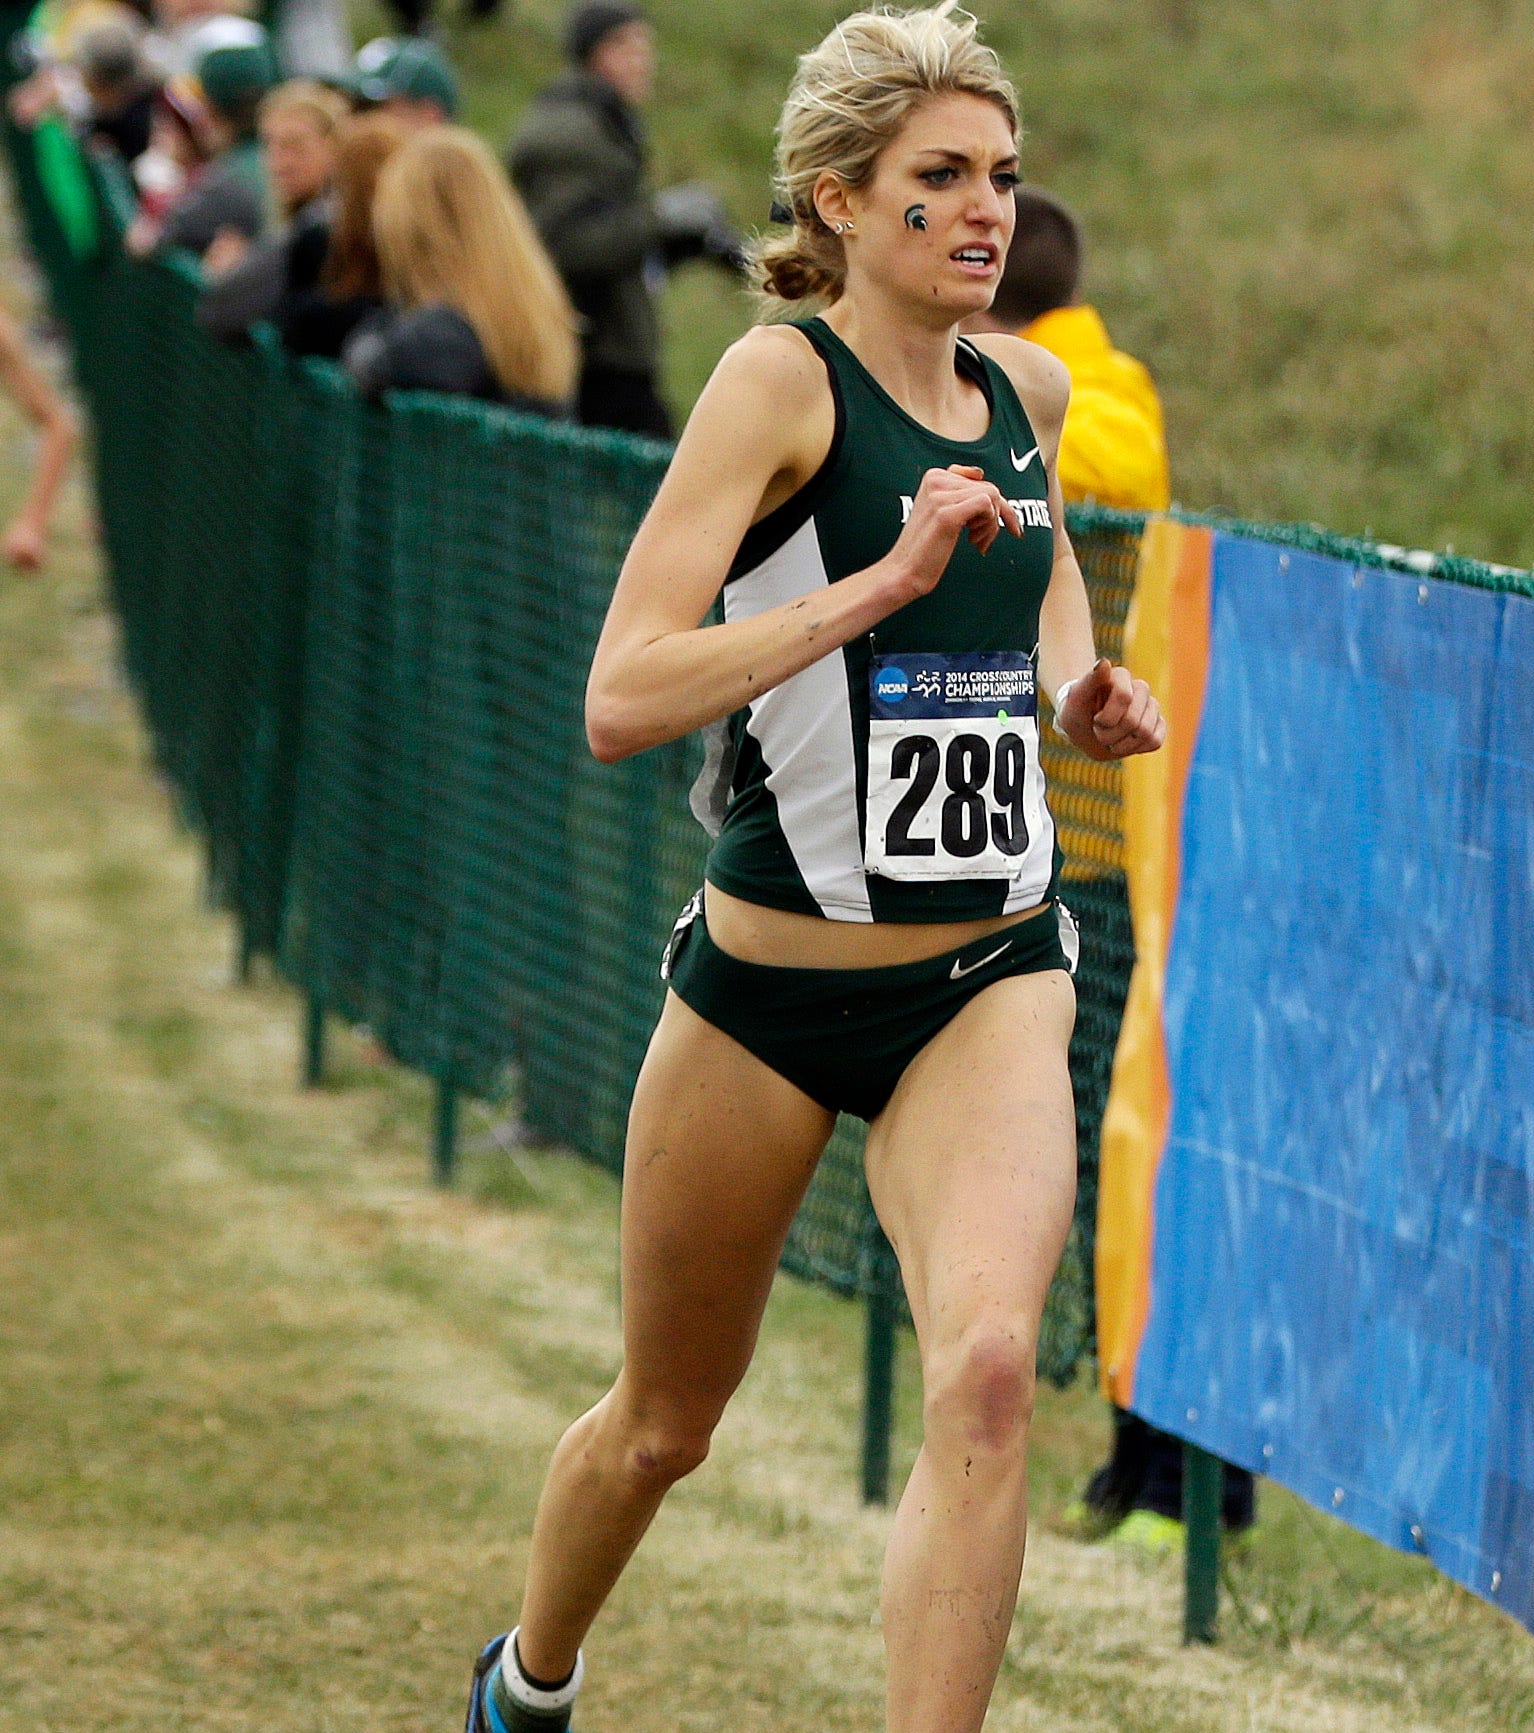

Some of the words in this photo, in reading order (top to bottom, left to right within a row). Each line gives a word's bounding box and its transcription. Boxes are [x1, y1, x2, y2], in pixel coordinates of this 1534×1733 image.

[945, 672, 968, 682] 2014
[945, 682, 1035, 697] CHAMPIONSHIPS
[885, 732, 1029, 858] 289
